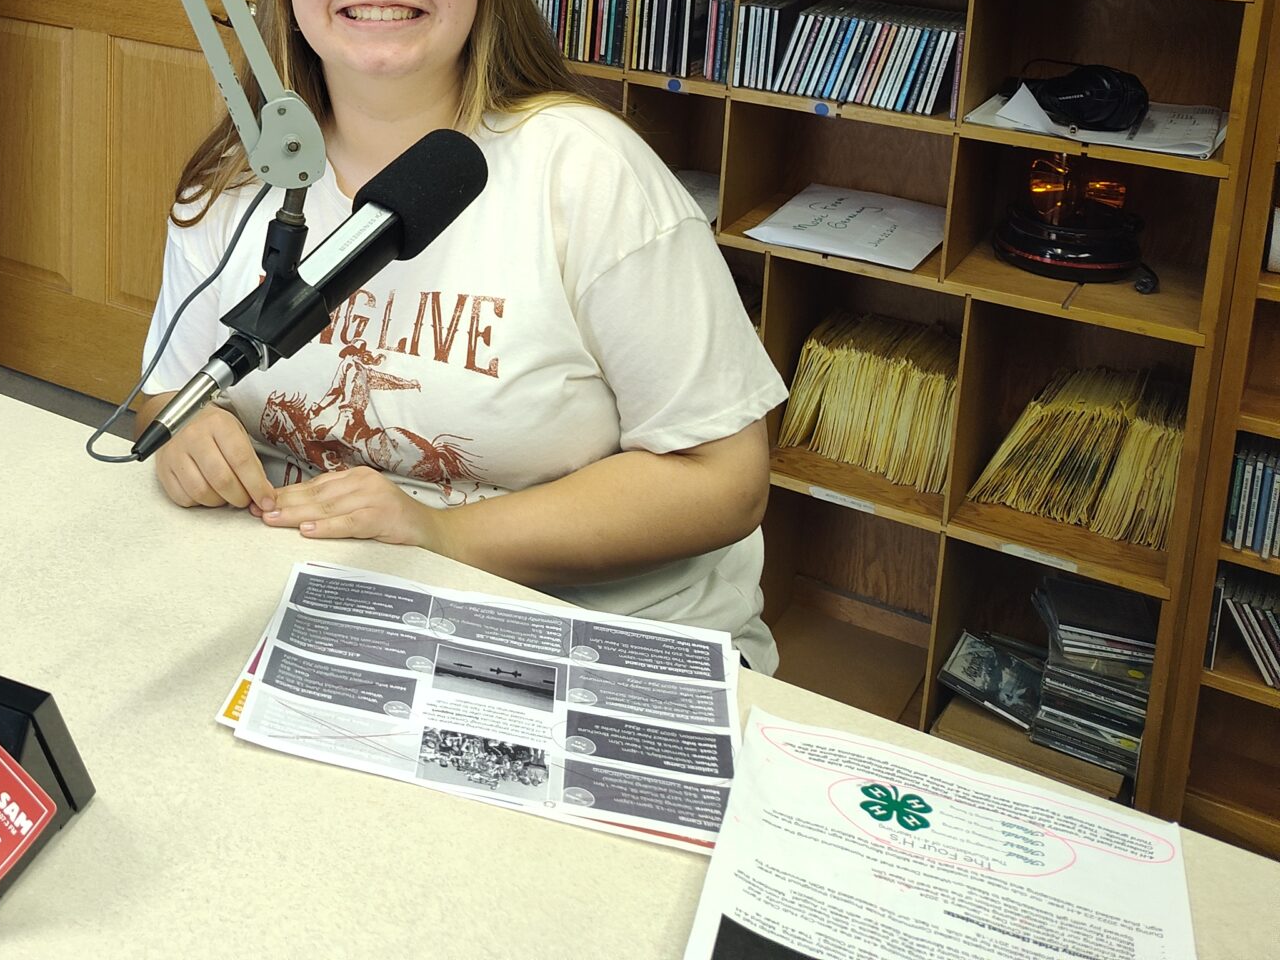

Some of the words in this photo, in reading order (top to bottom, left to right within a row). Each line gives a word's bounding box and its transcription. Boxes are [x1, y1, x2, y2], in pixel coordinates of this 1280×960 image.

[377, 289, 506, 378] LIVE
[887, 833, 914, 848] H's
[1001, 830, 1044, 847] Hands
[919, 844, 958, 860] Four
[941, 844, 989, 861] foundation
[1003, 841, 1045, 857] Heart
[963, 855, 991, 869] The
[1005, 851, 1045, 867] Head
